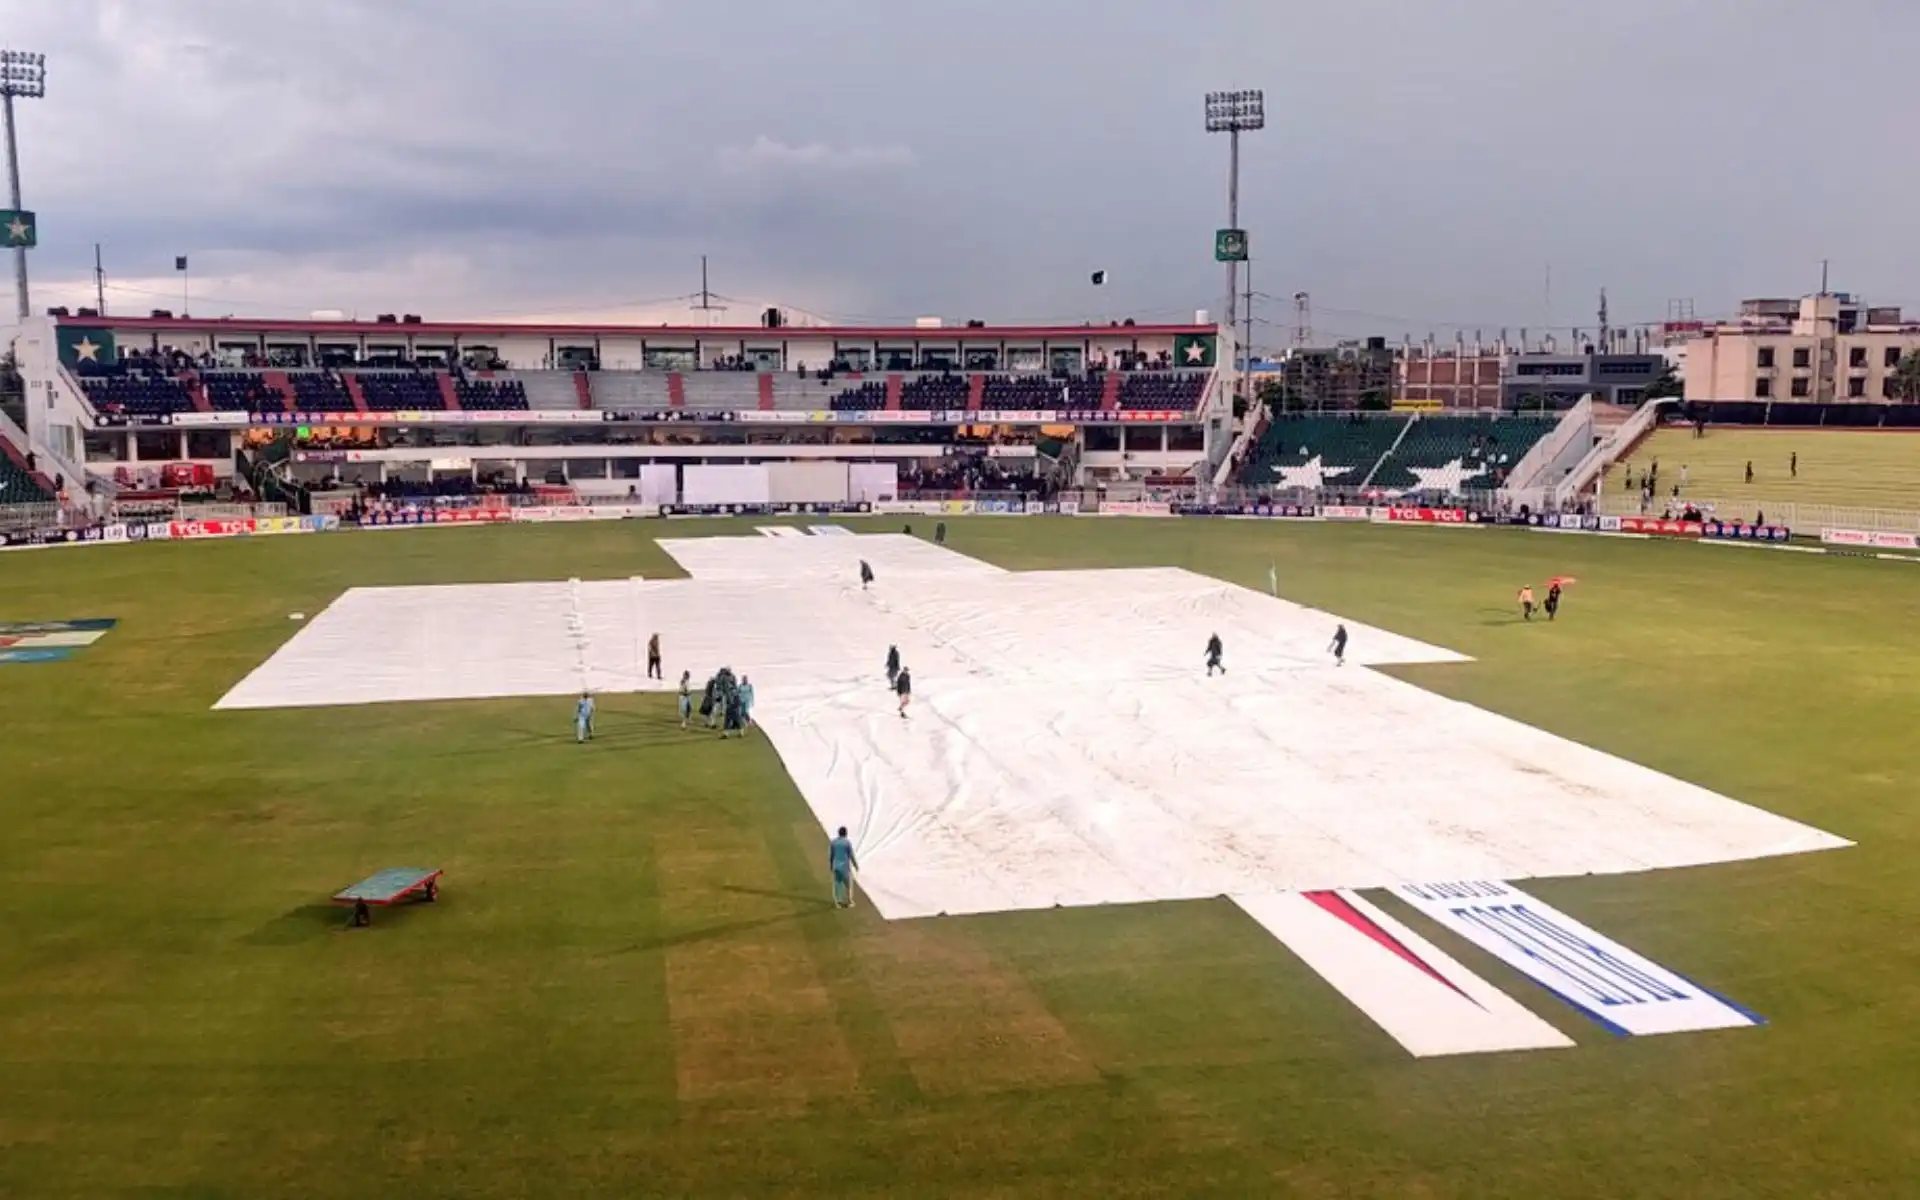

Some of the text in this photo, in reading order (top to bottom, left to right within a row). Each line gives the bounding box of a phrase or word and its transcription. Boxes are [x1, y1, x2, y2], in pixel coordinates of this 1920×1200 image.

[1396, 508, 1422, 520] TCL
[1432, 509, 1461, 522] TCL
[178, 522, 209, 536] TCL
[220, 520, 250, 534] TCL
